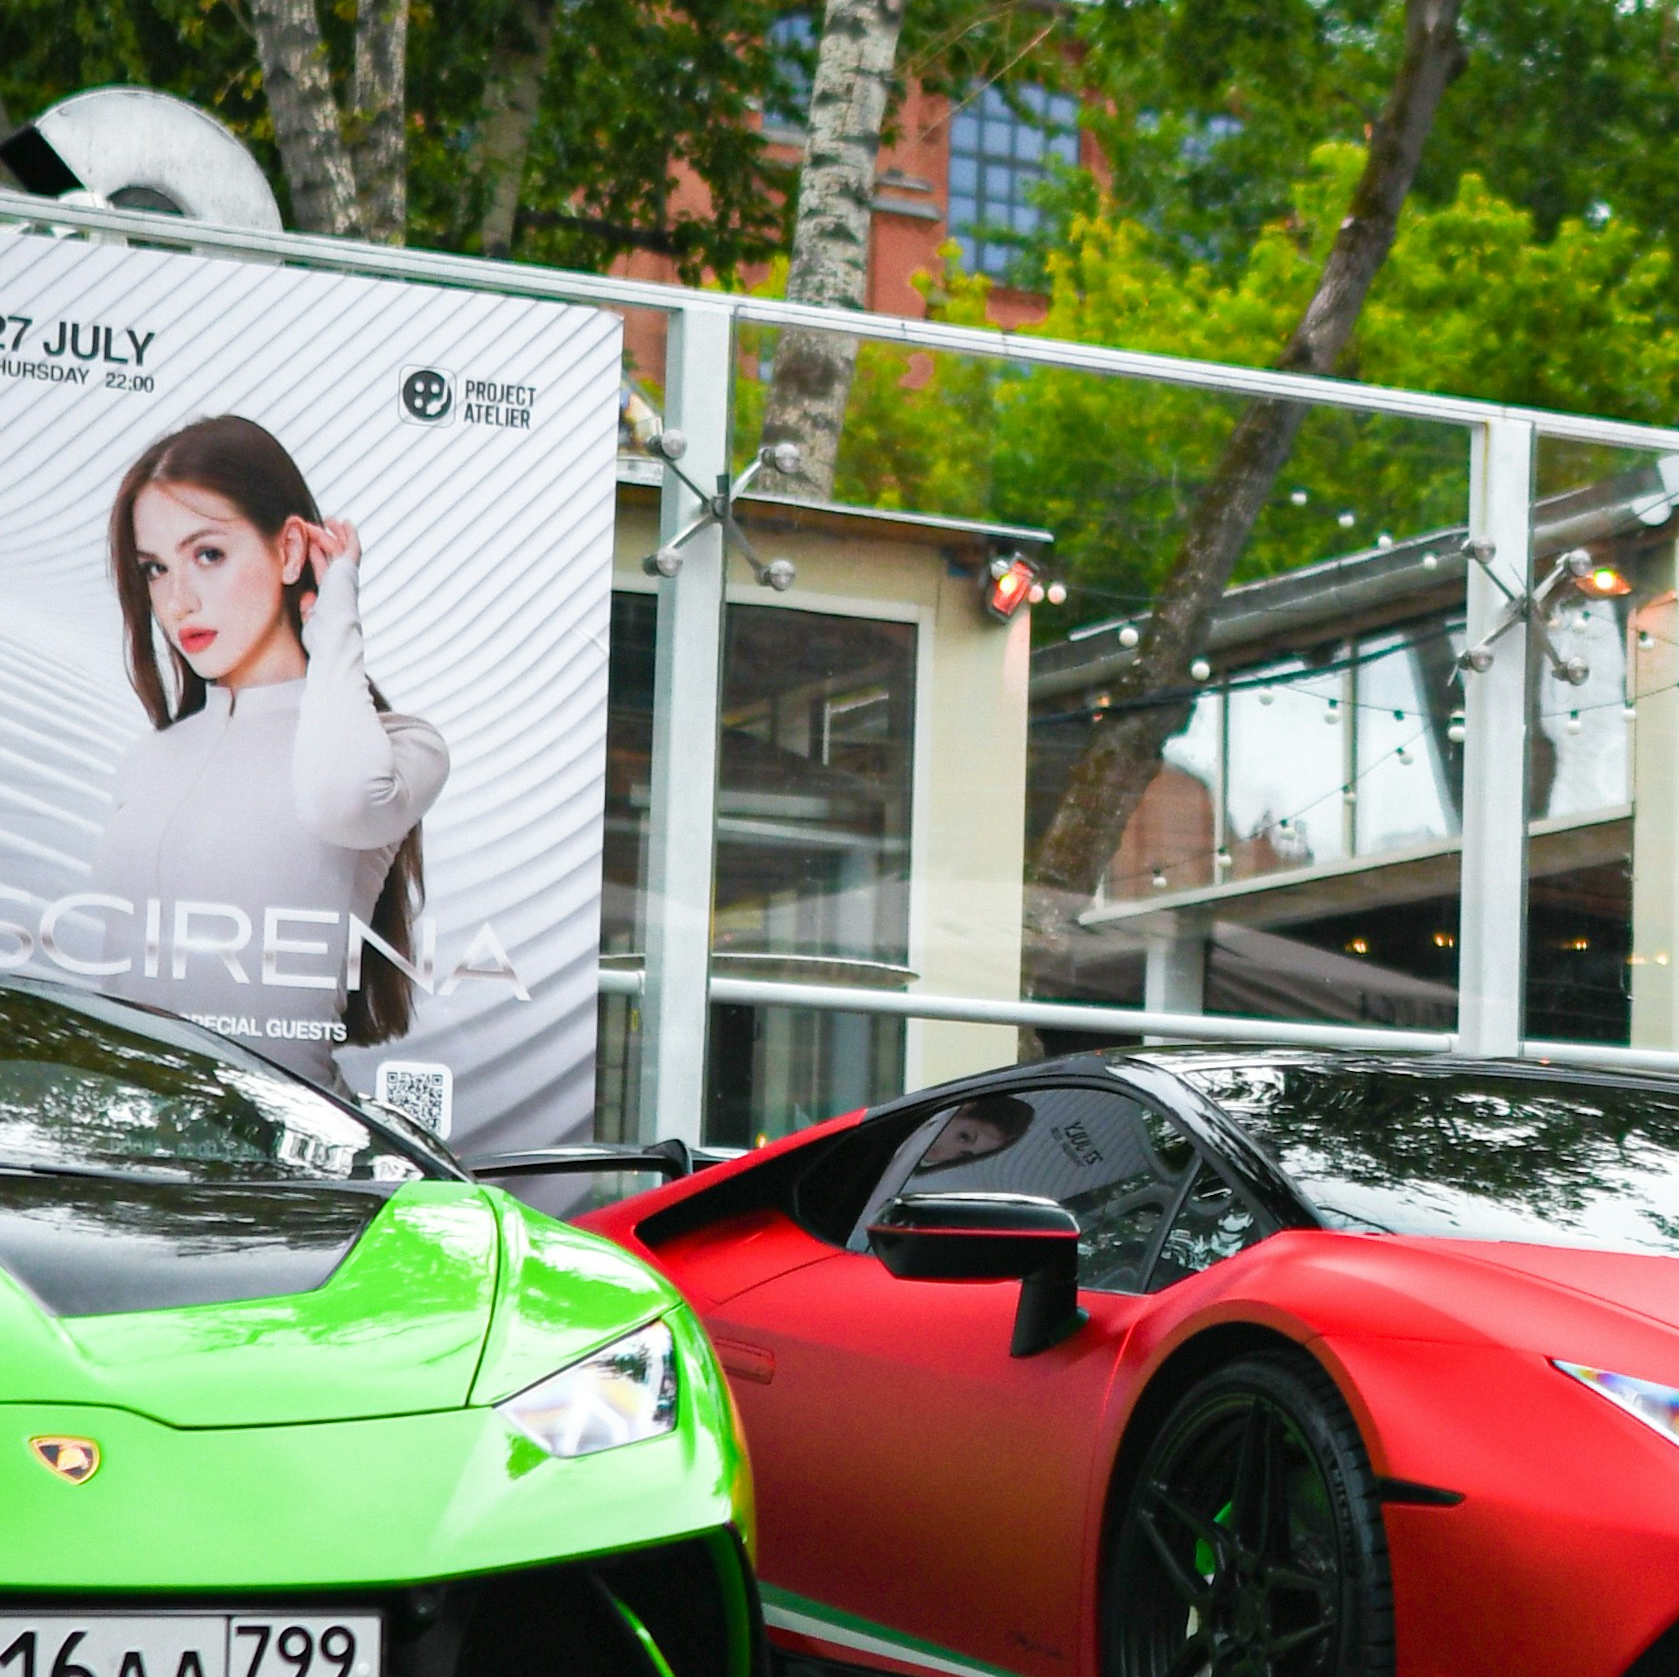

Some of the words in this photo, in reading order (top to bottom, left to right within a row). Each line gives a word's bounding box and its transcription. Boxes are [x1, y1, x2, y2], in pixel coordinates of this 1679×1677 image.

[0, 315, 33, 351] 7
[43, 321, 155, 367] JULY
[105, 372, 155, 393] 22:00
[465, 380, 537, 407] PROJECT
[463, 403, 531, 429] ATELIER
[266, 1019, 348, 1043] GUESTS
